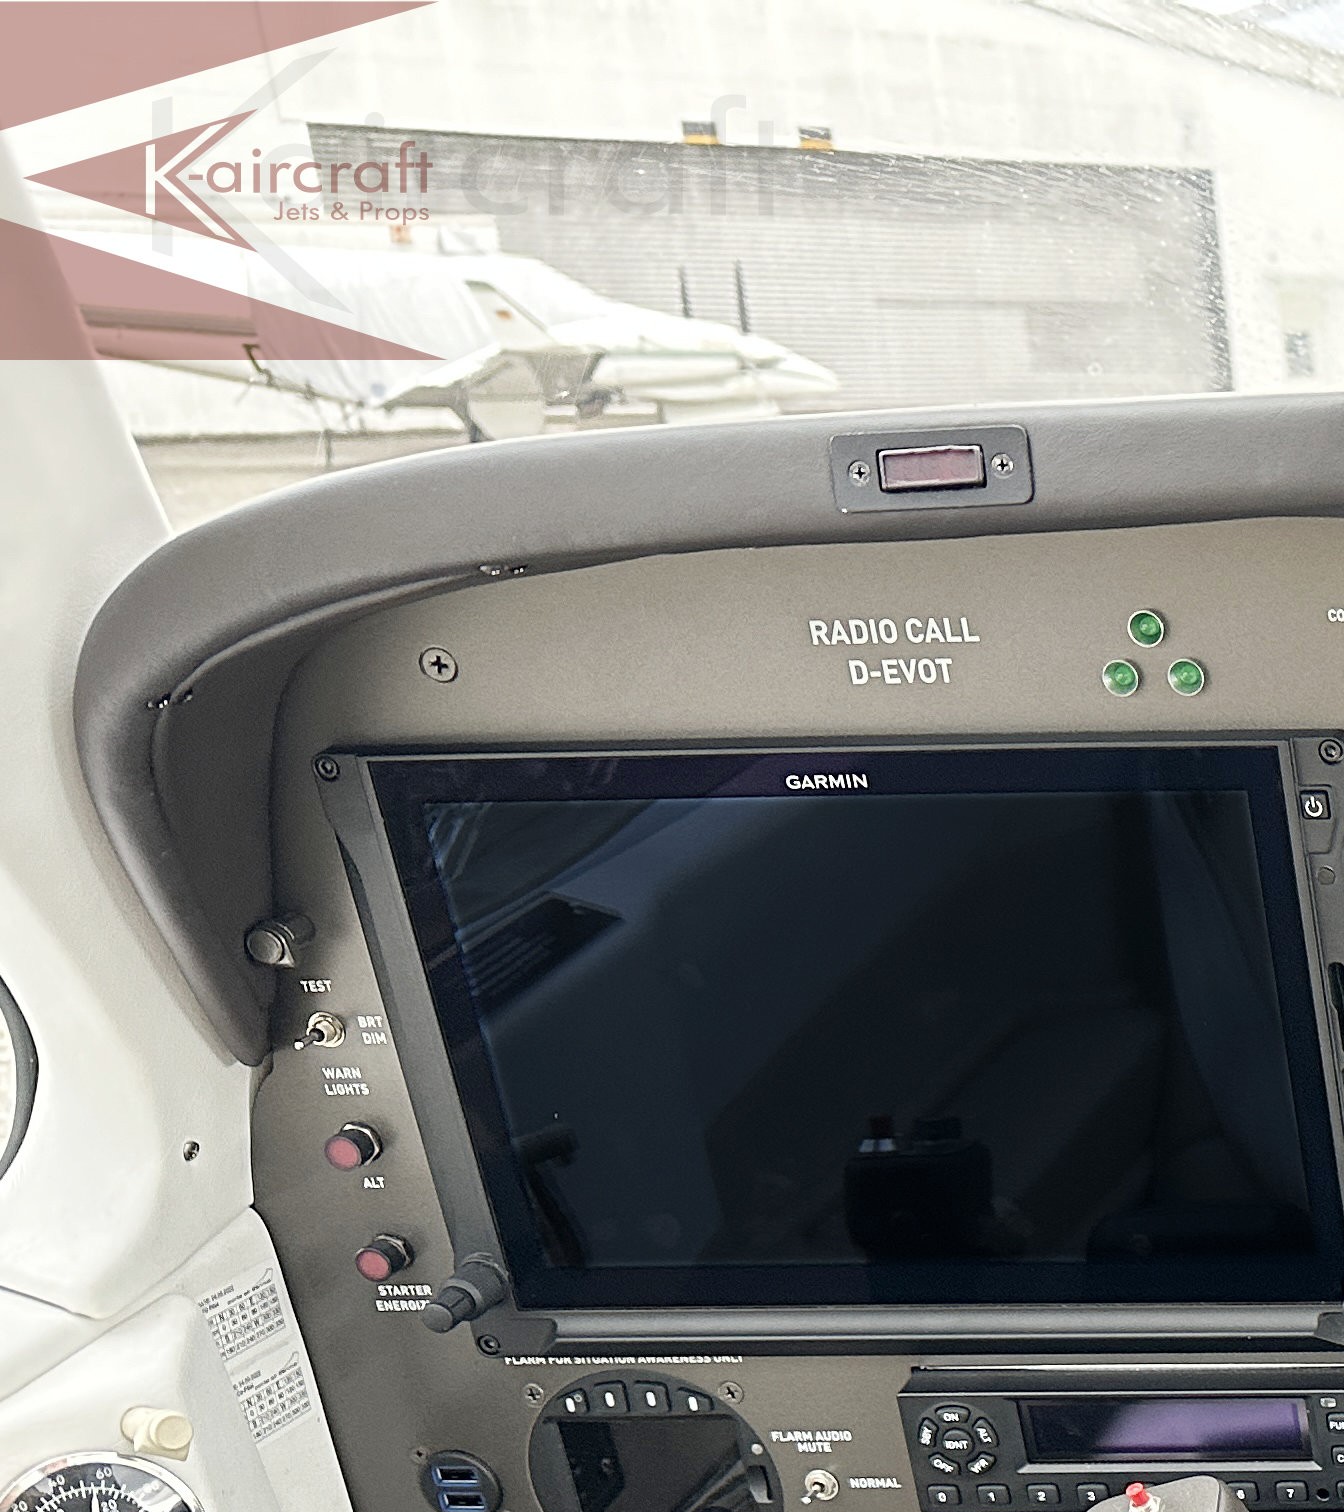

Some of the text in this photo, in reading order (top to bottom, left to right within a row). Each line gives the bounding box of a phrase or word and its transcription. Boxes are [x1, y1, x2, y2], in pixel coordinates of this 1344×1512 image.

[809, 618, 979, 646] RADIO CALL
[849, 659, 952, 685] D-EVOT
[786, 774, 868, 790] GARMIN
[300, 980, 332, 993] TEST
[322, 1067, 362, 1080] WARN
[325, 1083, 370, 1096] LIGHTS
[363, 1177, 385, 1189] ALT
[378, 1285, 432, 1297] STARTER
[771, 1431, 852, 1442] FLARM AUDIO
[798, 1442, 832, 1452] MUTE
[96, 1466, 112, 1479] 60
[850, 1478, 902, 1489] NORMAL
